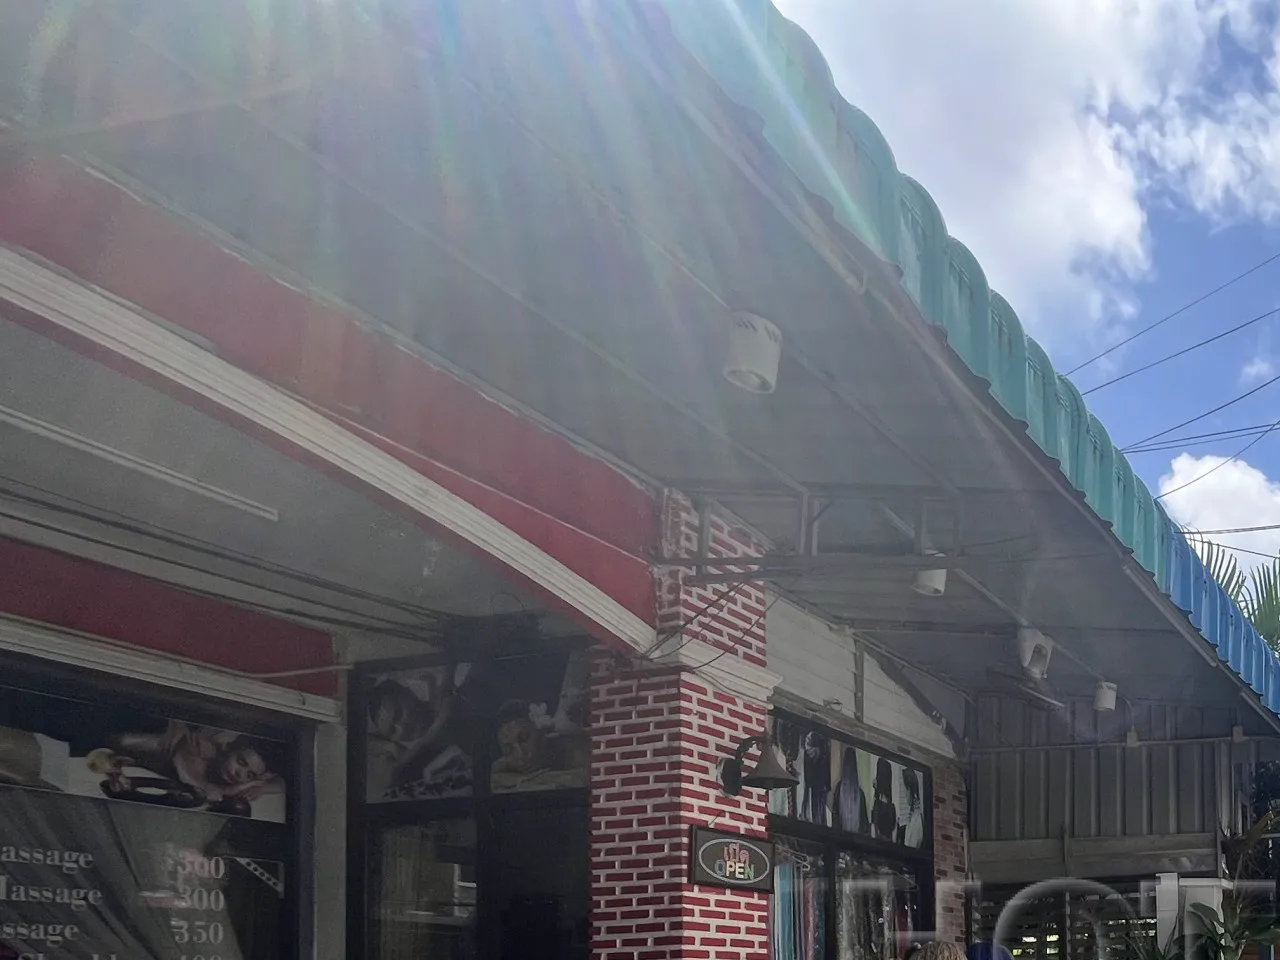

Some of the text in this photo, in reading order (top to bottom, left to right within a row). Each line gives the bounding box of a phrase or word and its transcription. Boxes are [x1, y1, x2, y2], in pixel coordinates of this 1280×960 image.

[714, 859, 755, 881] OPEN
[0, 918, 224, 947] ssage 350
